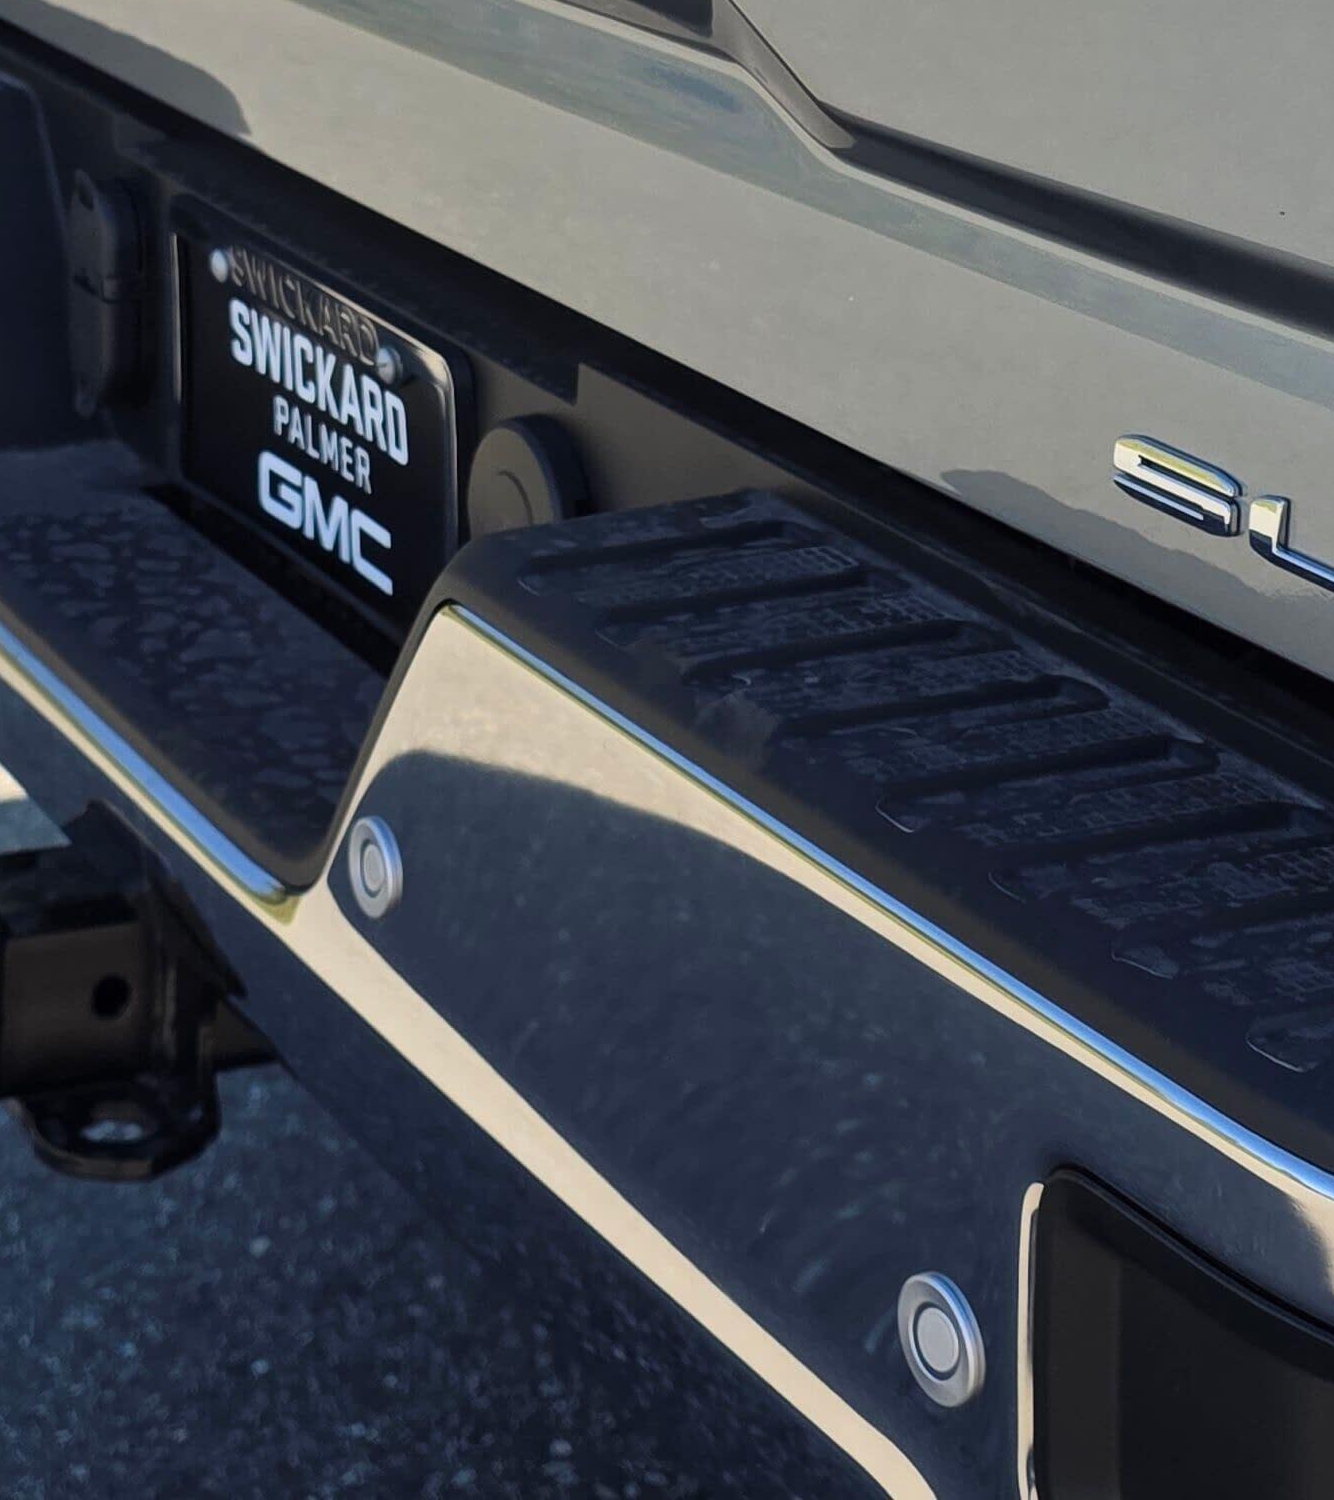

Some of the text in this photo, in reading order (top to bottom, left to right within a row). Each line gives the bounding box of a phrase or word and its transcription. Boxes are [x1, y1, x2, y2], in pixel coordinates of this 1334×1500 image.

[229, 246, 381, 367] SWICKARD
[229, 298, 410, 467] SWICKARD
[273, 395, 372, 495] PALMER
[257, 450, 394, 597] GMC
